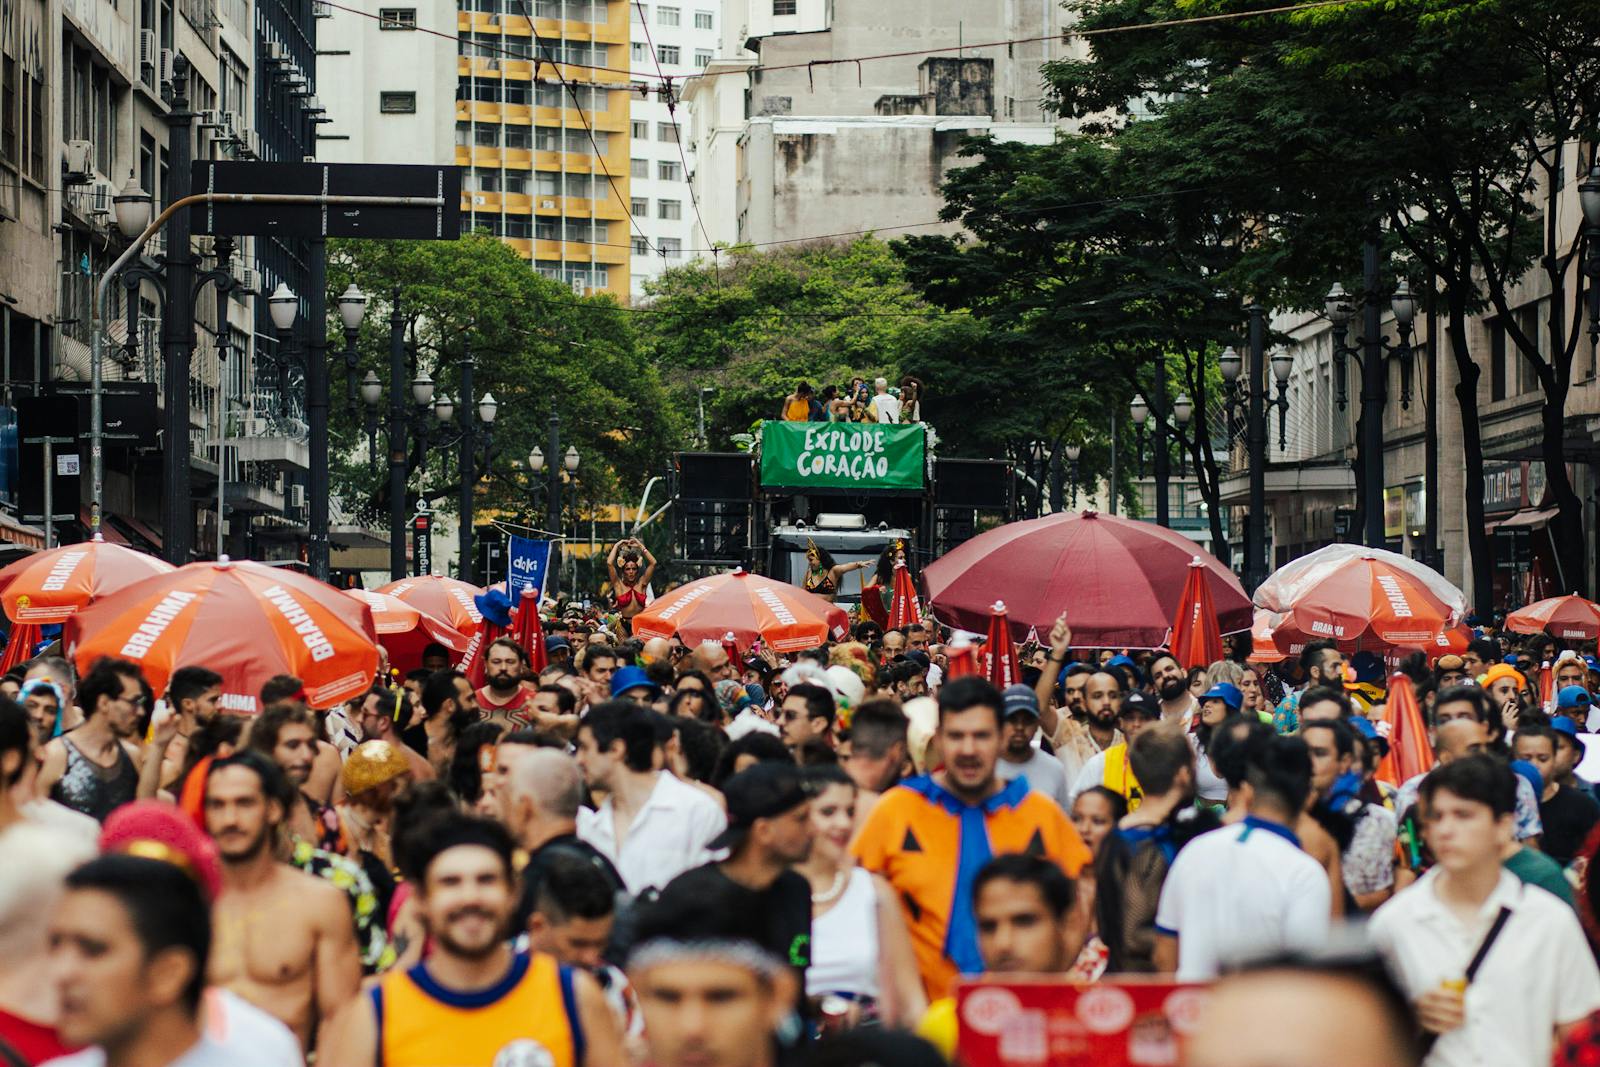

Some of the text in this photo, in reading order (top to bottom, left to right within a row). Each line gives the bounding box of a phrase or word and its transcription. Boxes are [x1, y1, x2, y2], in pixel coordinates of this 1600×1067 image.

[804, 428, 885, 453] EXPLODE
[796, 451, 888, 480] CORAÇÃO
[41, 551, 89, 591] BRAHMA
[658, 585, 713, 619] BRAHMA
[754, 587, 798, 625] BRAHMA
[1377, 575, 1413, 617] BRAHMA
[120, 590, 197, 659] BRAHMA
[262, 585, 335, 662] BRAHMA
[1563, 629, 1586, 638] BRAHMA
